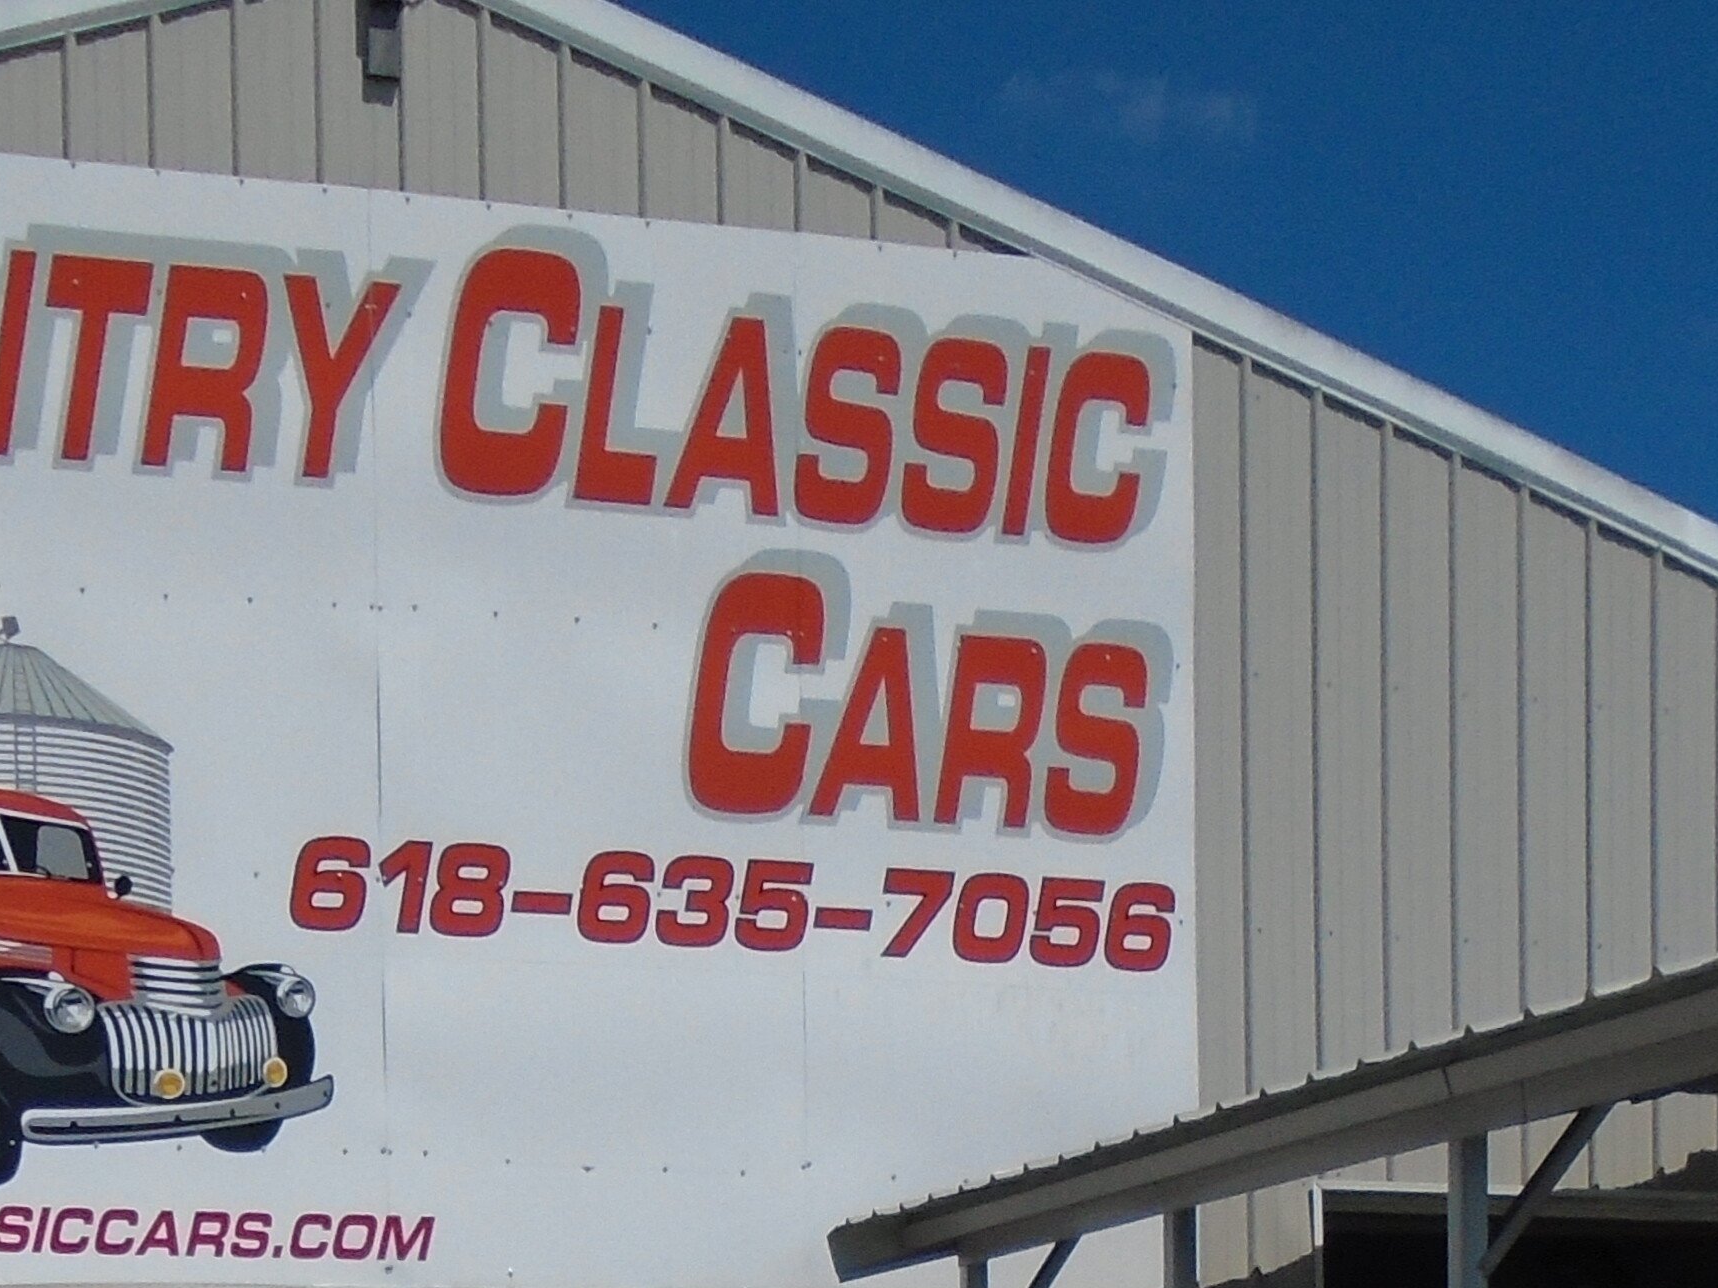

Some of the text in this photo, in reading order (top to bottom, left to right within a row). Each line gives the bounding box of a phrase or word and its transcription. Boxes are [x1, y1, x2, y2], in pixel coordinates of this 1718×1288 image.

[438, 246, 1153, 545] CLASSIC
[686, 571, 1151, 836] CARS
[288, 835, 1177, 972] 618-635-7056
